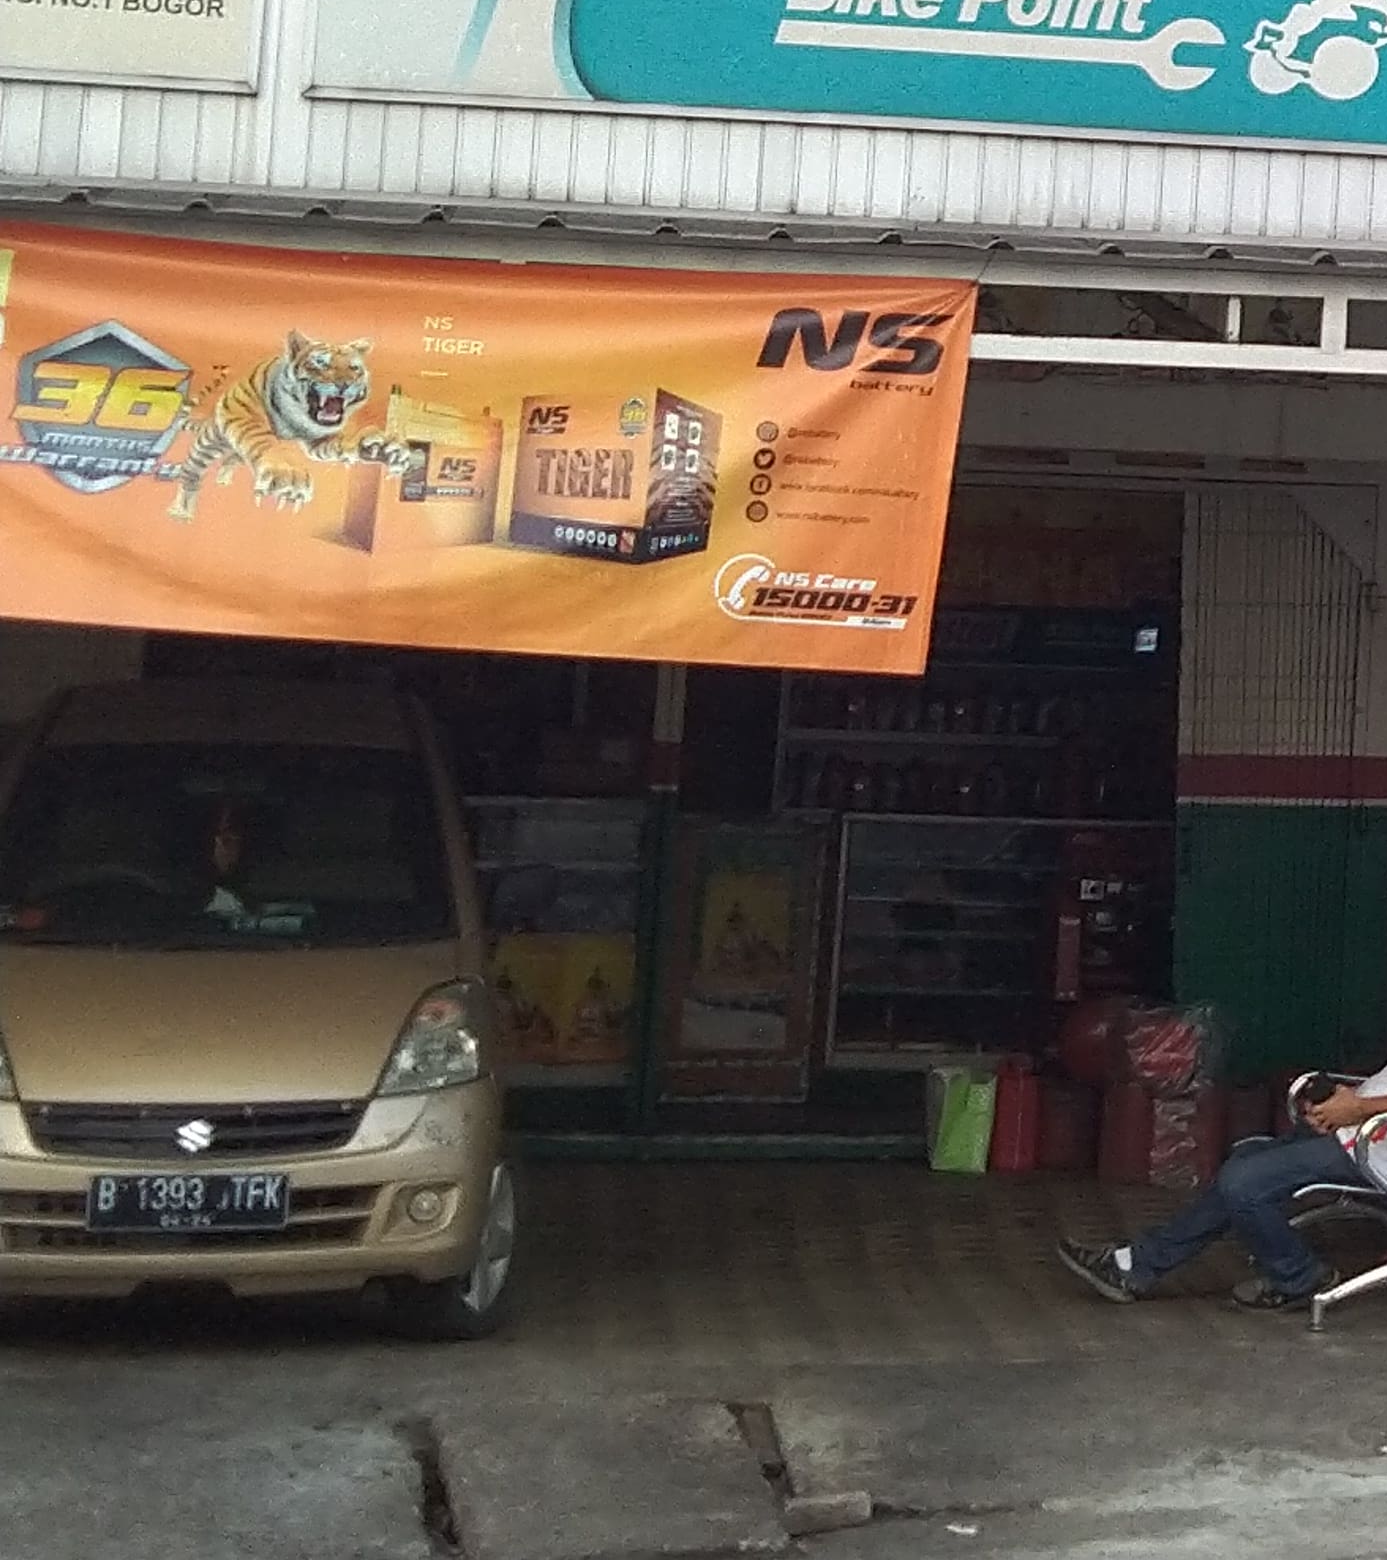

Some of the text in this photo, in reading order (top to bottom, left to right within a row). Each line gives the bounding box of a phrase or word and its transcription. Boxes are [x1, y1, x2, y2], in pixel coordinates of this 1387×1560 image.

[424, 315, 454, 331] NS
[422, 336, 485, 356] TIGER
[755, 306, 955, 375] NS
[11, 361, 191, 430] 36
[849, 378, 935, 397] battery
[528, 405, 571, 426] NS
[535, 447, 635, 500] TIGER
[774, 571, 810, 588] NS
[752, 587, 919, 615] 15000-31
[97, 1177, 118, 1211] B
[136, 1177, 206, 1211] 1393
